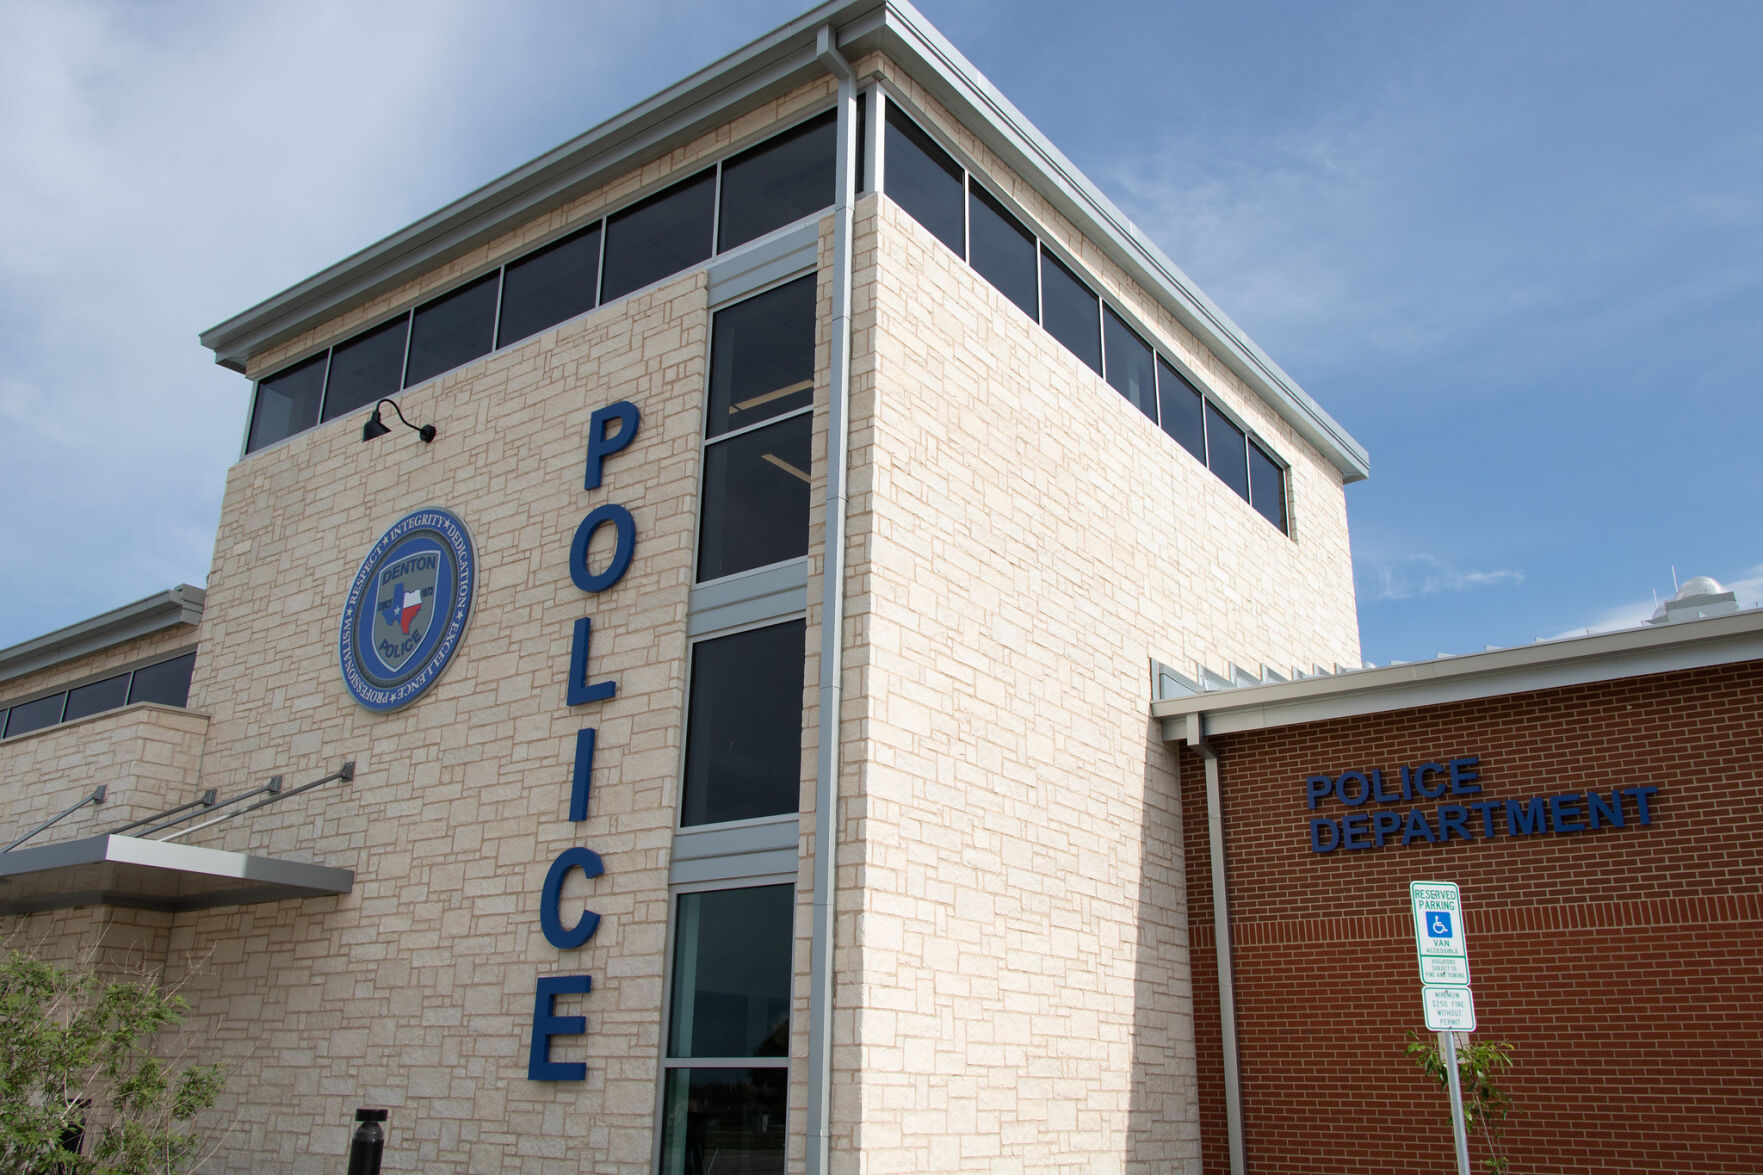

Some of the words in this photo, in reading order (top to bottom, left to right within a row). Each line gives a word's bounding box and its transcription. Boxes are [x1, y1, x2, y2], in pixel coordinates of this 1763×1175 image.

[390, 514, 444, 541] INTEGRITY
[350, 543, 383, 605] RESPECT
[383, 556, 436, 585] DENTON
[448, 524, 469, 608] DEDICATION
[343, 619, 388, 704] PROFESSIONALISM
[379, 629, 424, 658] POLICE
[396, 622, 459, 699] EXCELLENCE
[528, 401, 640, 1081] POLICE
[1306, 757, 1482, 810] POLICE
[1310, 786, 1659, 853] DEPARTMENT
[1415, 889, 1456, 900] RESERVED
[1419, 900, 1455, 910] PARKING
